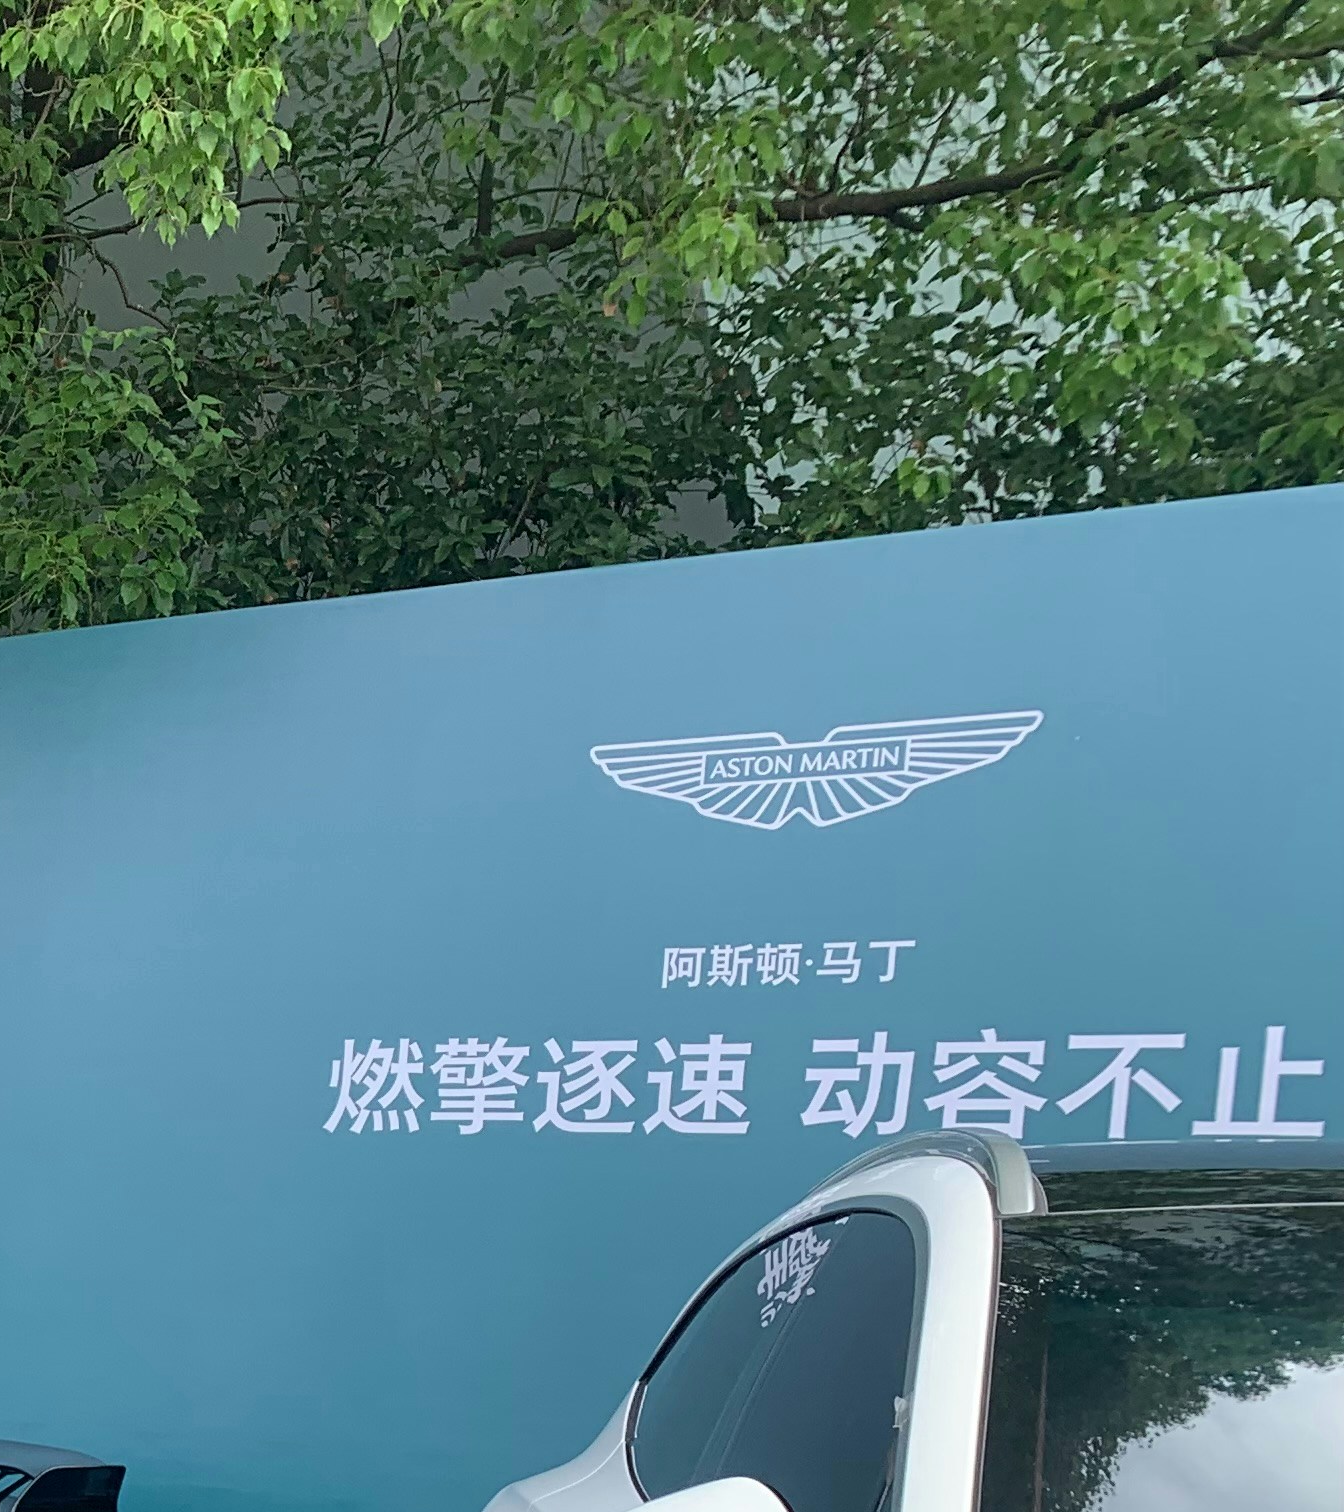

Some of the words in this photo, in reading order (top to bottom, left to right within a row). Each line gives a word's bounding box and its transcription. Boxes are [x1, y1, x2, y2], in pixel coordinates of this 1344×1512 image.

[710, 754, 793, 779] ASTON
[800, 746, 900, 773] MARTIN
[661, 940, 916, 989] 阿斯顿·马丁
[323, 1034, 753, 1135] 燃擎逐速
[800, 1026, 1325, 1139] 动容不止
